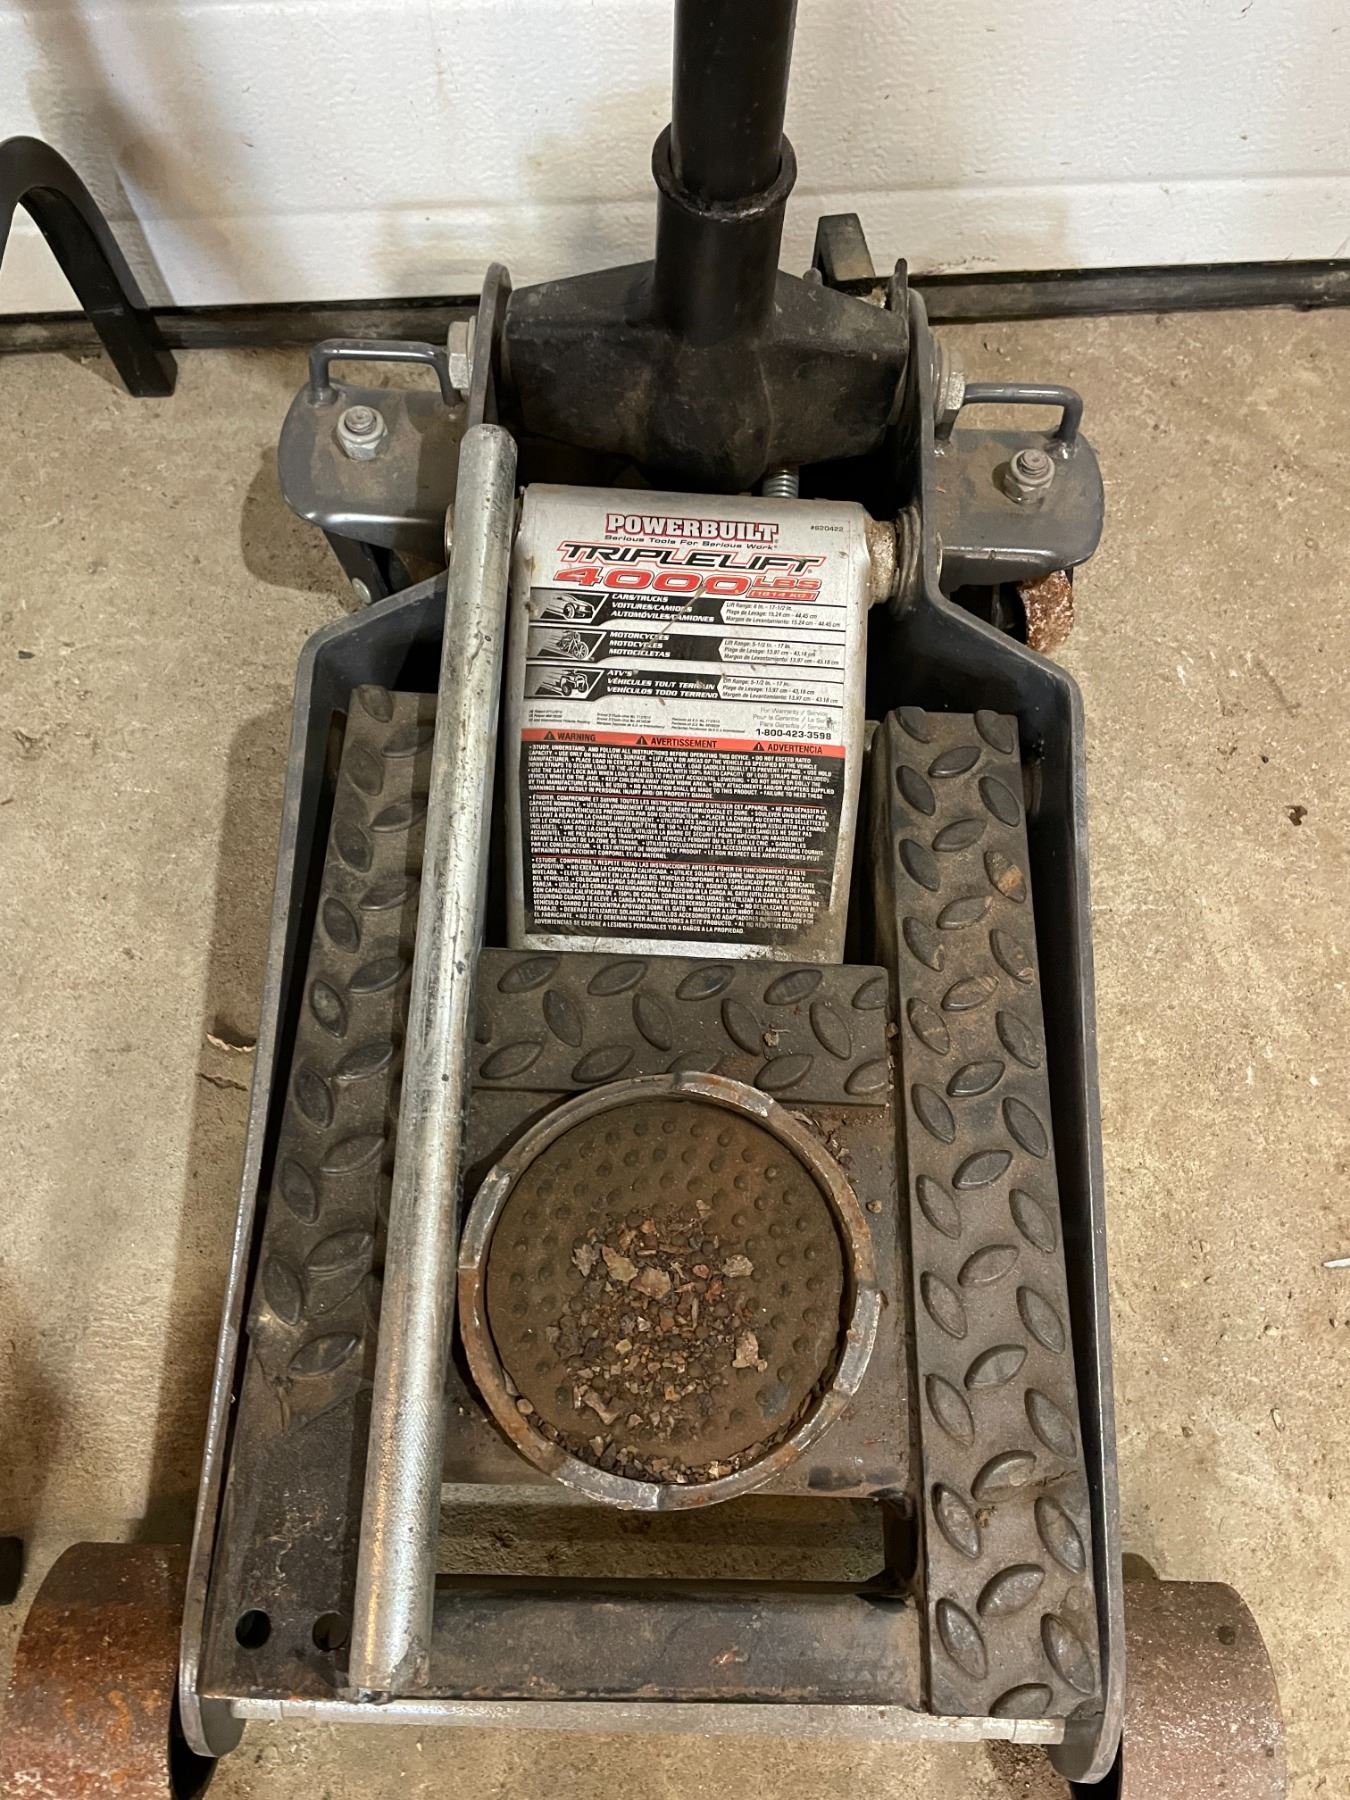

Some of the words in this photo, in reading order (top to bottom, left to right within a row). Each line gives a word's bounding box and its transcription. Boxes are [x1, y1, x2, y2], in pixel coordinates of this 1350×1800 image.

[605, 513, 779, 543] POWERBUILT
[604, 534, 644, 542] Serious
[648, 536, 675, 544] Tools
[702, 540, 742, 548] Serious
[559, 542, 823, 574] TRIPLELIFT
[553, 566, 752, 596] 4000
[750, 575, 822, 591] LBS
[611, 593, 668, 602] CARS/TRUCKS
[611, 601, 692, 612] VOITURES/CAMIOS
[611, 609, 715, 622] AUTOMÓVILES/CAMIONES
[609, 631, 670, 641] MOTORCYCES
[608, 648, 670, 657] MOTOCICLETAS
[607, 677, 652, 686] VÉHICULES
[678, 681, 714, 690] TERIN
[606, 685, 652, 694] VEHÍCULOS
[654, 688, 677, 696] TODO
[679, 690, 718, 698] TERRENO
[557, 732, 596, 742] WARNING
[755, 728, 831, 739] 1-800-423-3598
[651, 737, 717, 748] AVERTISSEMENT
[768, 744, 823, 754] ADVERTENCIA
